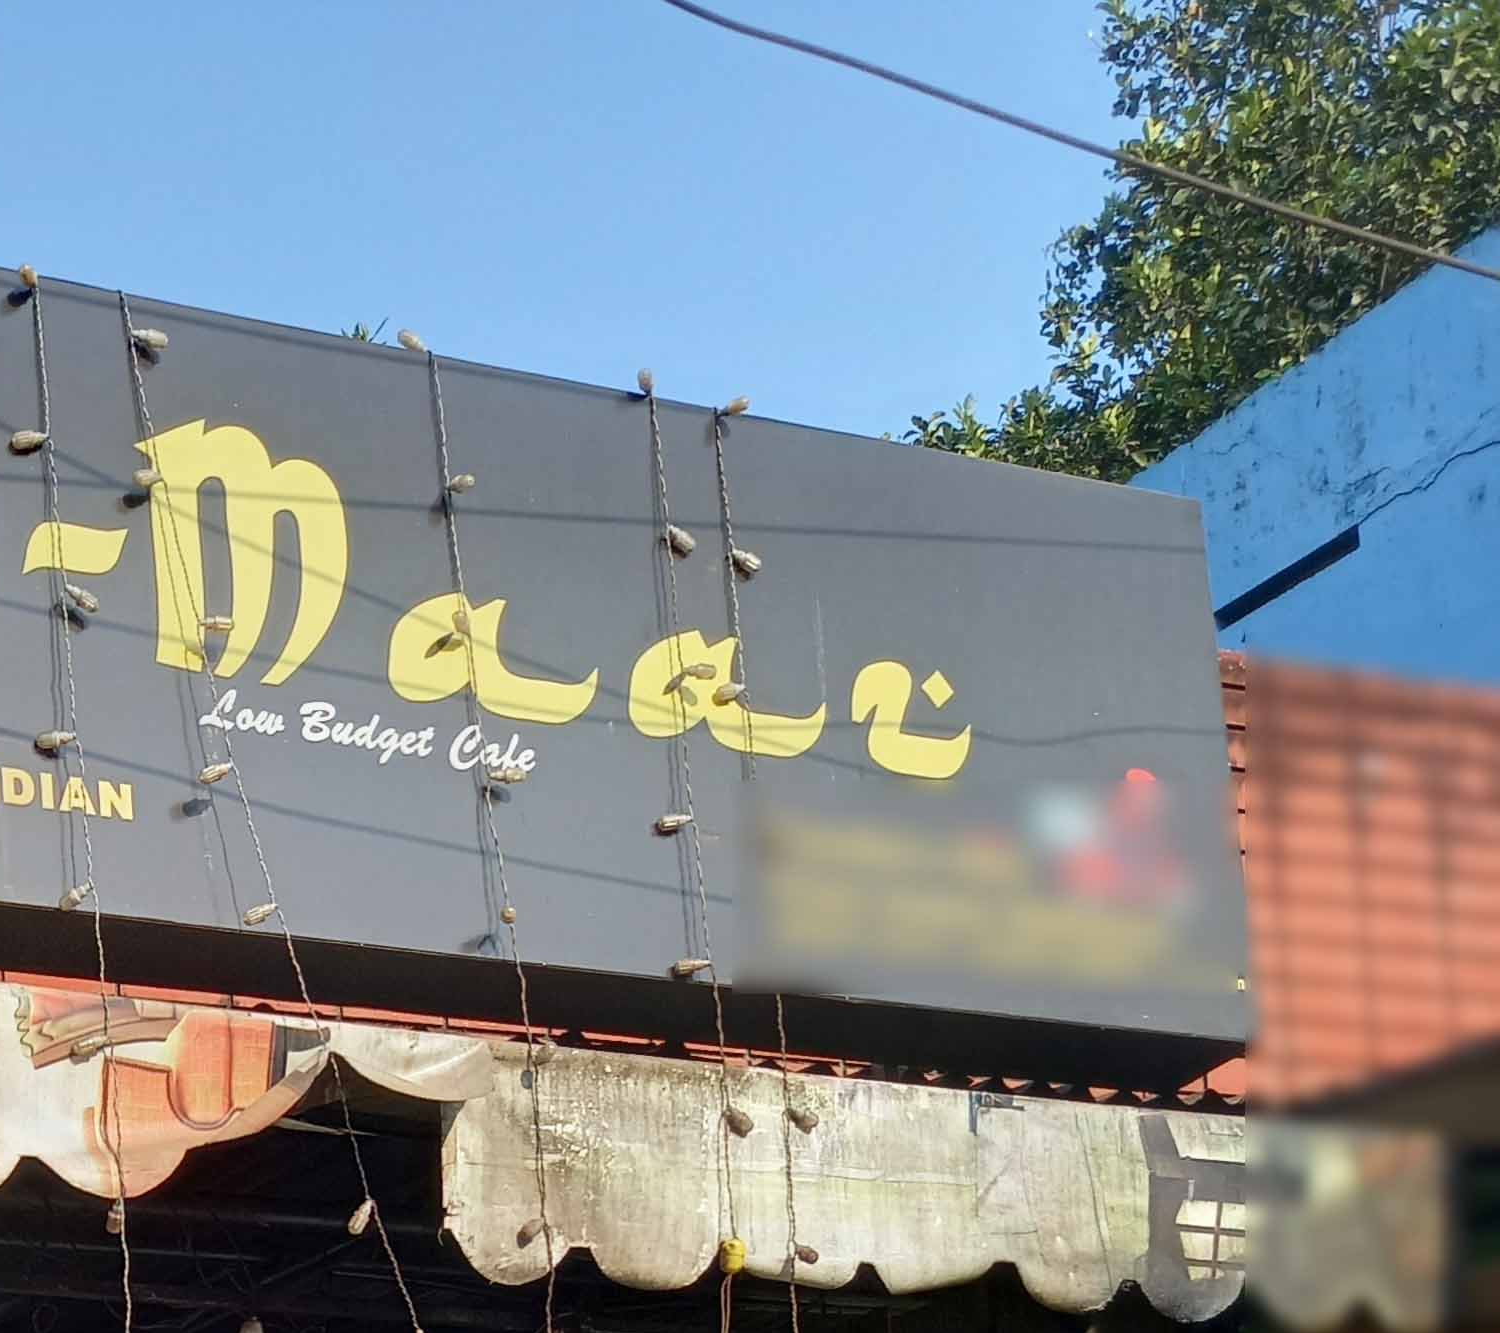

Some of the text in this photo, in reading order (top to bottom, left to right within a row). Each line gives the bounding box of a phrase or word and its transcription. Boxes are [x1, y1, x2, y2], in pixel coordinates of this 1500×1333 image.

[199, 689, 536, 773] Low Budget Cafe
